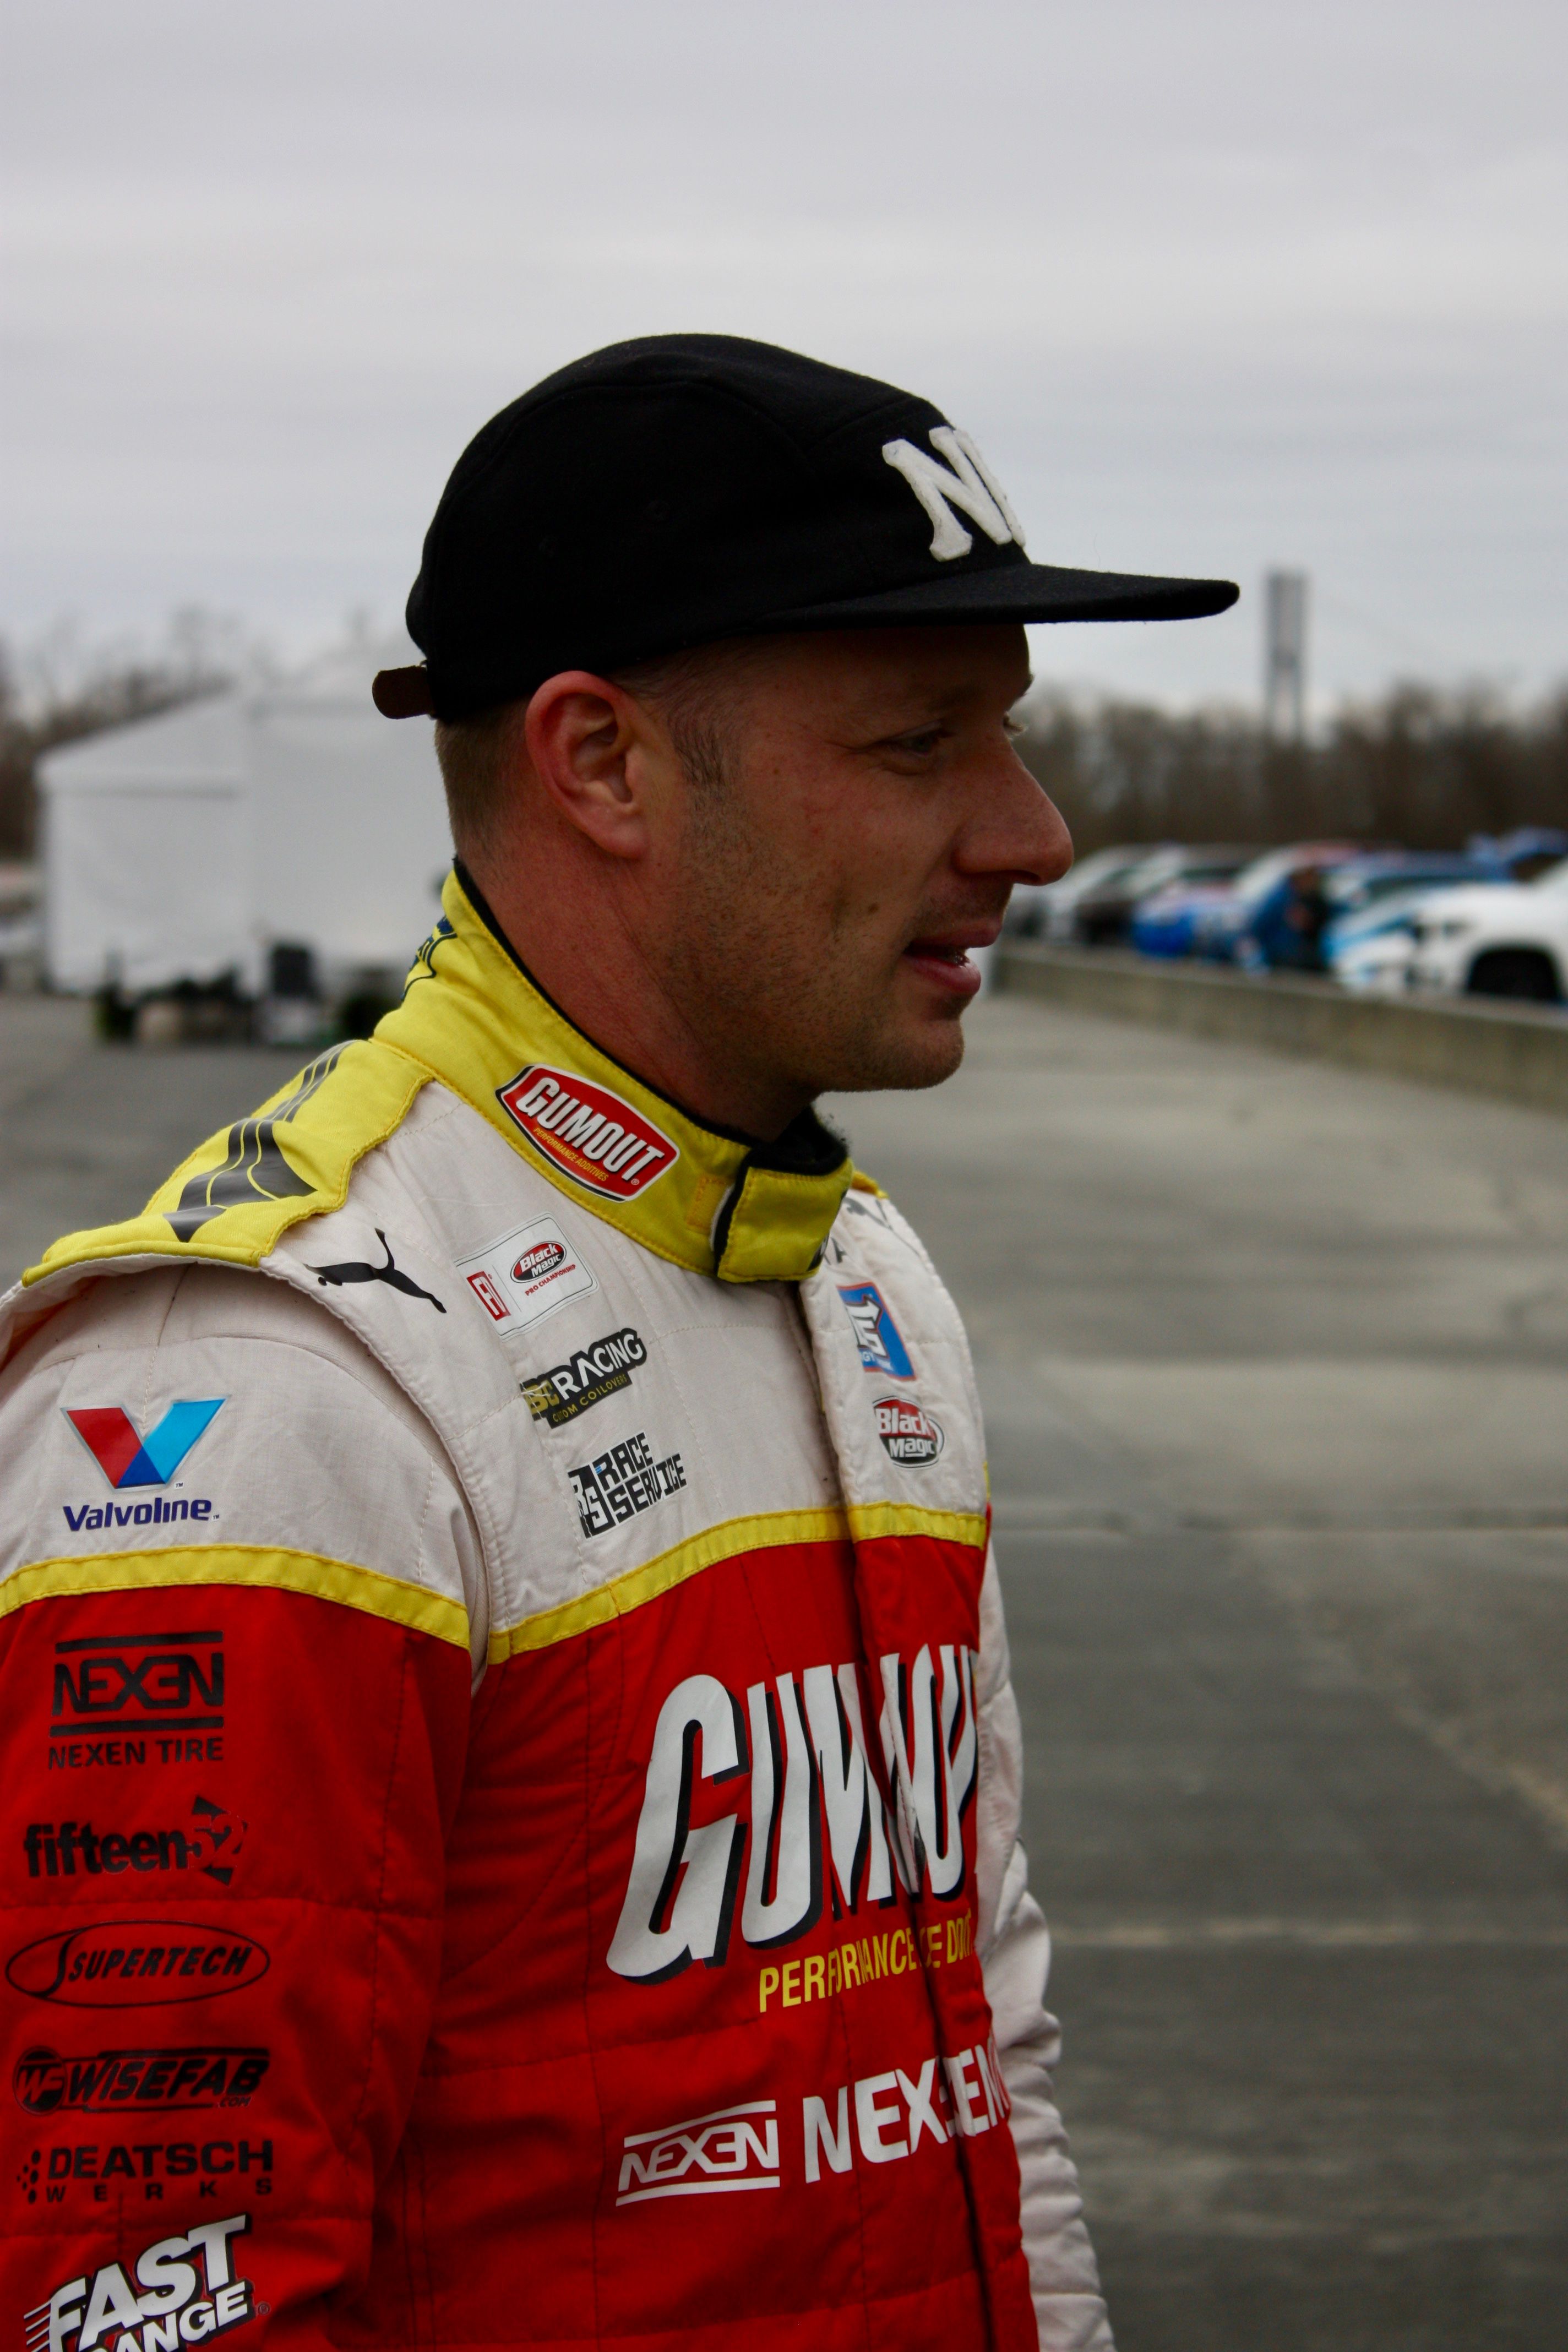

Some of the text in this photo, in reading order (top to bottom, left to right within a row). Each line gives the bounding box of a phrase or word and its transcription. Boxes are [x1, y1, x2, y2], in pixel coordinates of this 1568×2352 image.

[515, 1077, 665, 1181] GUMOUT
[533, 1128, 609, 1182] PERFORMANCE ADDITIVES
[520, 1243, 558, 1272] Black
[525, 1264, 576, 1296] PRO CHAMPIONSHIP
[531, 1254, 562, 1278] Magic
[551, 1333, 644, 1401] RACING
[579, 1374, 628, 1406] COILOVERS
[592, 1432, 654, 1491] RACE
[606, 1453, 687, 1524] SERVICE
[62, 1497, 212, 1532] Valvoline
[51, 1652, 224, 1717] NEXEN
[48, 1737, 225, 1770] NEXEN TIRE
[68, 1946, 253, 1982] SUPERTECH
[67, 2058, 270, 2104] WISEFAB
[48, 2140, 274, 2180] DEATSCH
[618, 2119, 780, 2192] NEXEN
[47, 2213, 248, 2352] FAST
